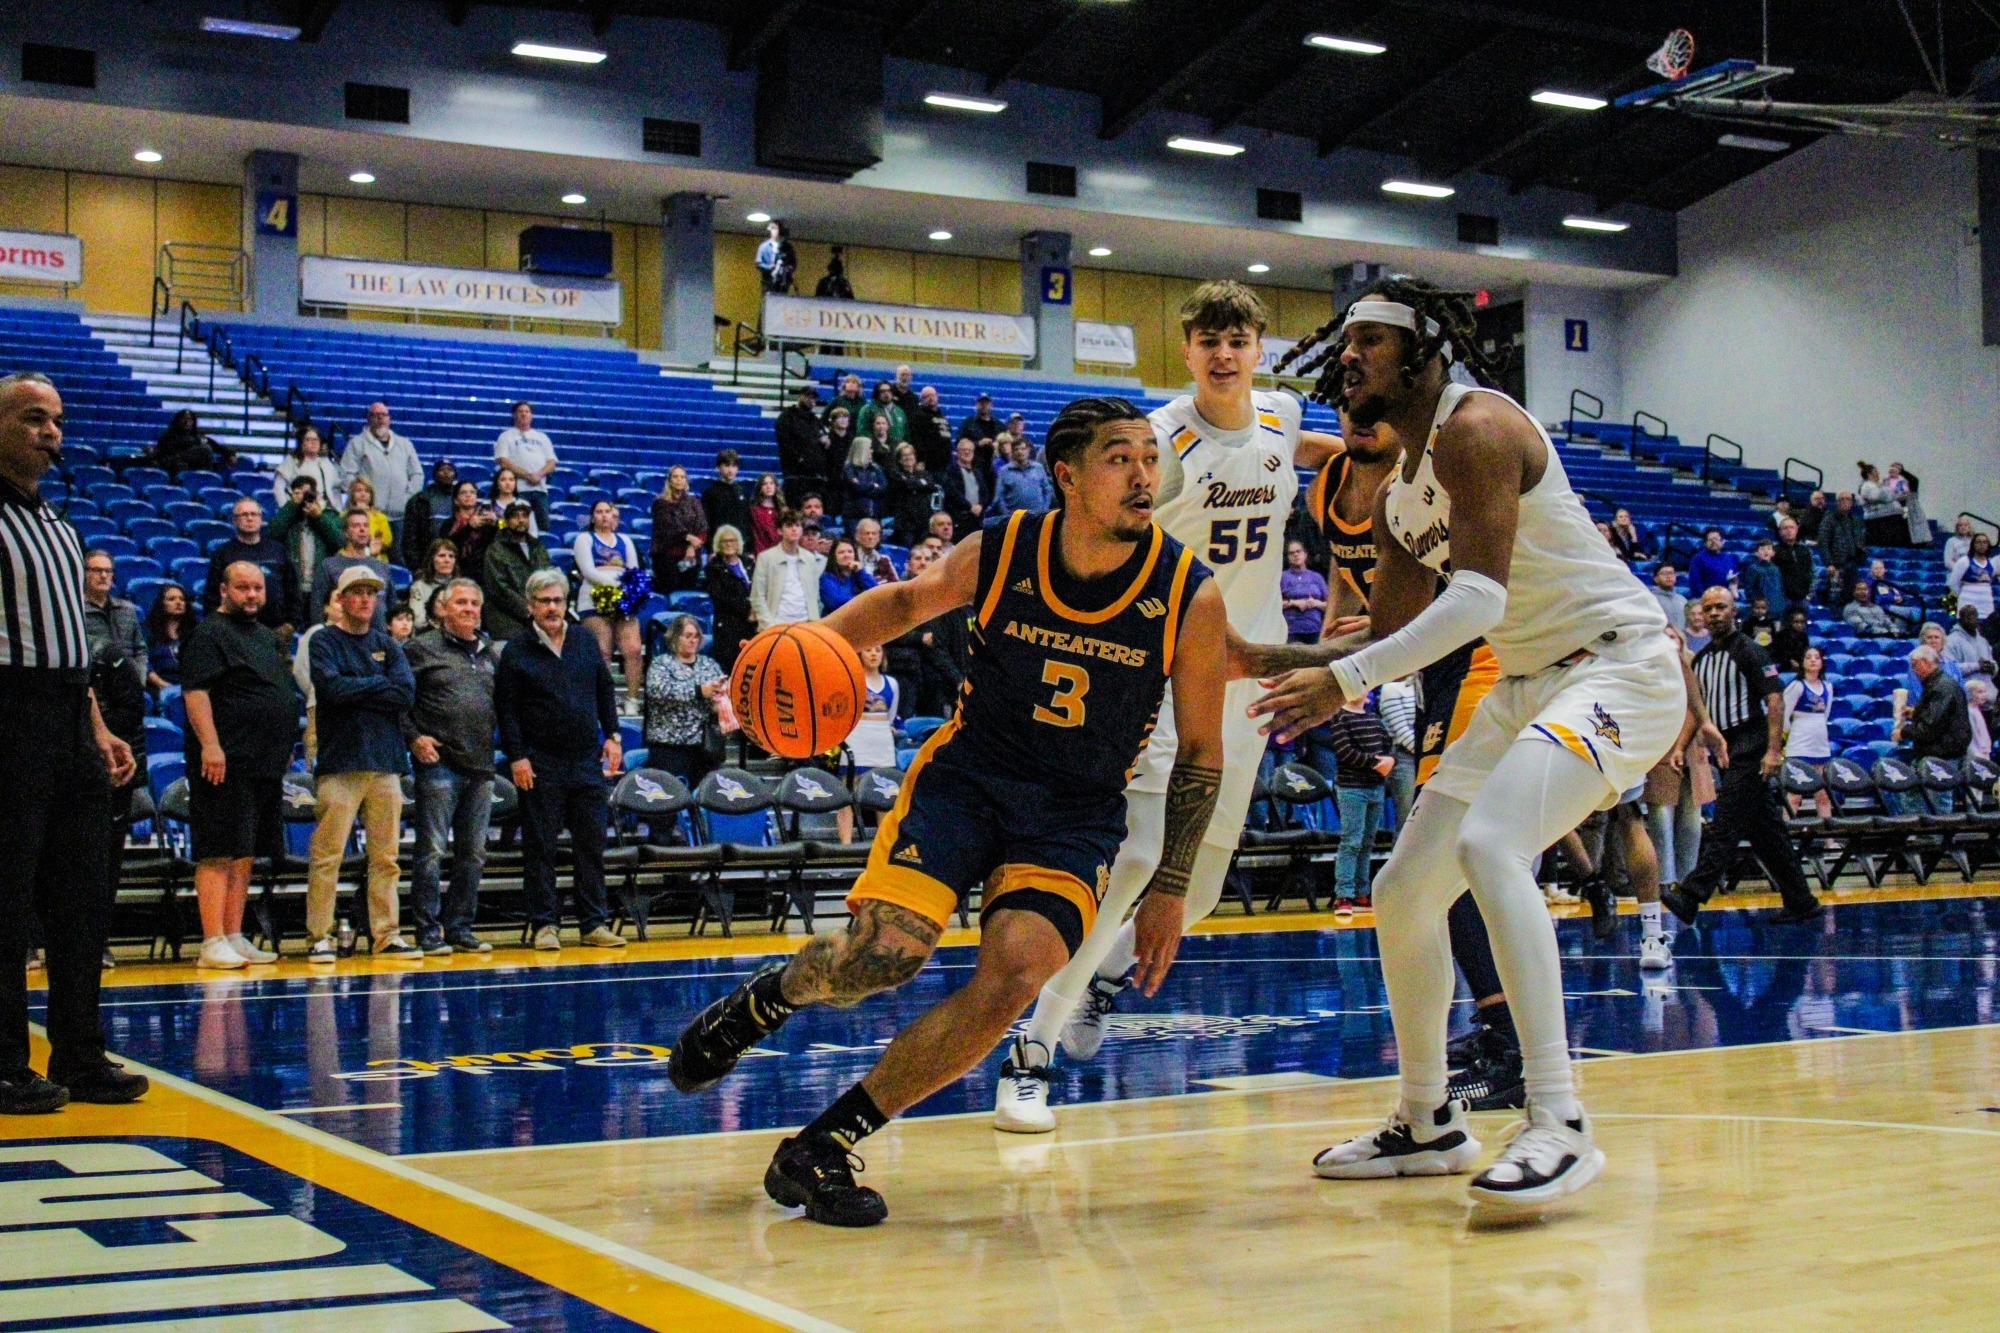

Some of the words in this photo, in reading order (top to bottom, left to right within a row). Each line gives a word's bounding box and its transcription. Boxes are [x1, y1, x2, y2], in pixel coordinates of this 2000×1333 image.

[266, 200, 289, 230] 4
[347, 273, 393, 293] THE
[399, 277, 448, 296] LAW
[455, 281, 547, 304] OFFICES
[552, 288, 582, 307] OF
[1048, 272, 1064, 300] 3
[818, 310, 886, 332] DIXON
[893, 317, 987, 340] KUMMER
[1571, 323, 1582, 348] 1
[1203, 481, 1277, 509] Runners
[1208, 515, 1271, 565] 55
[1003, 620, 1147, 667] ANTEATERS
[1032, 658, 1090, 728] 3
